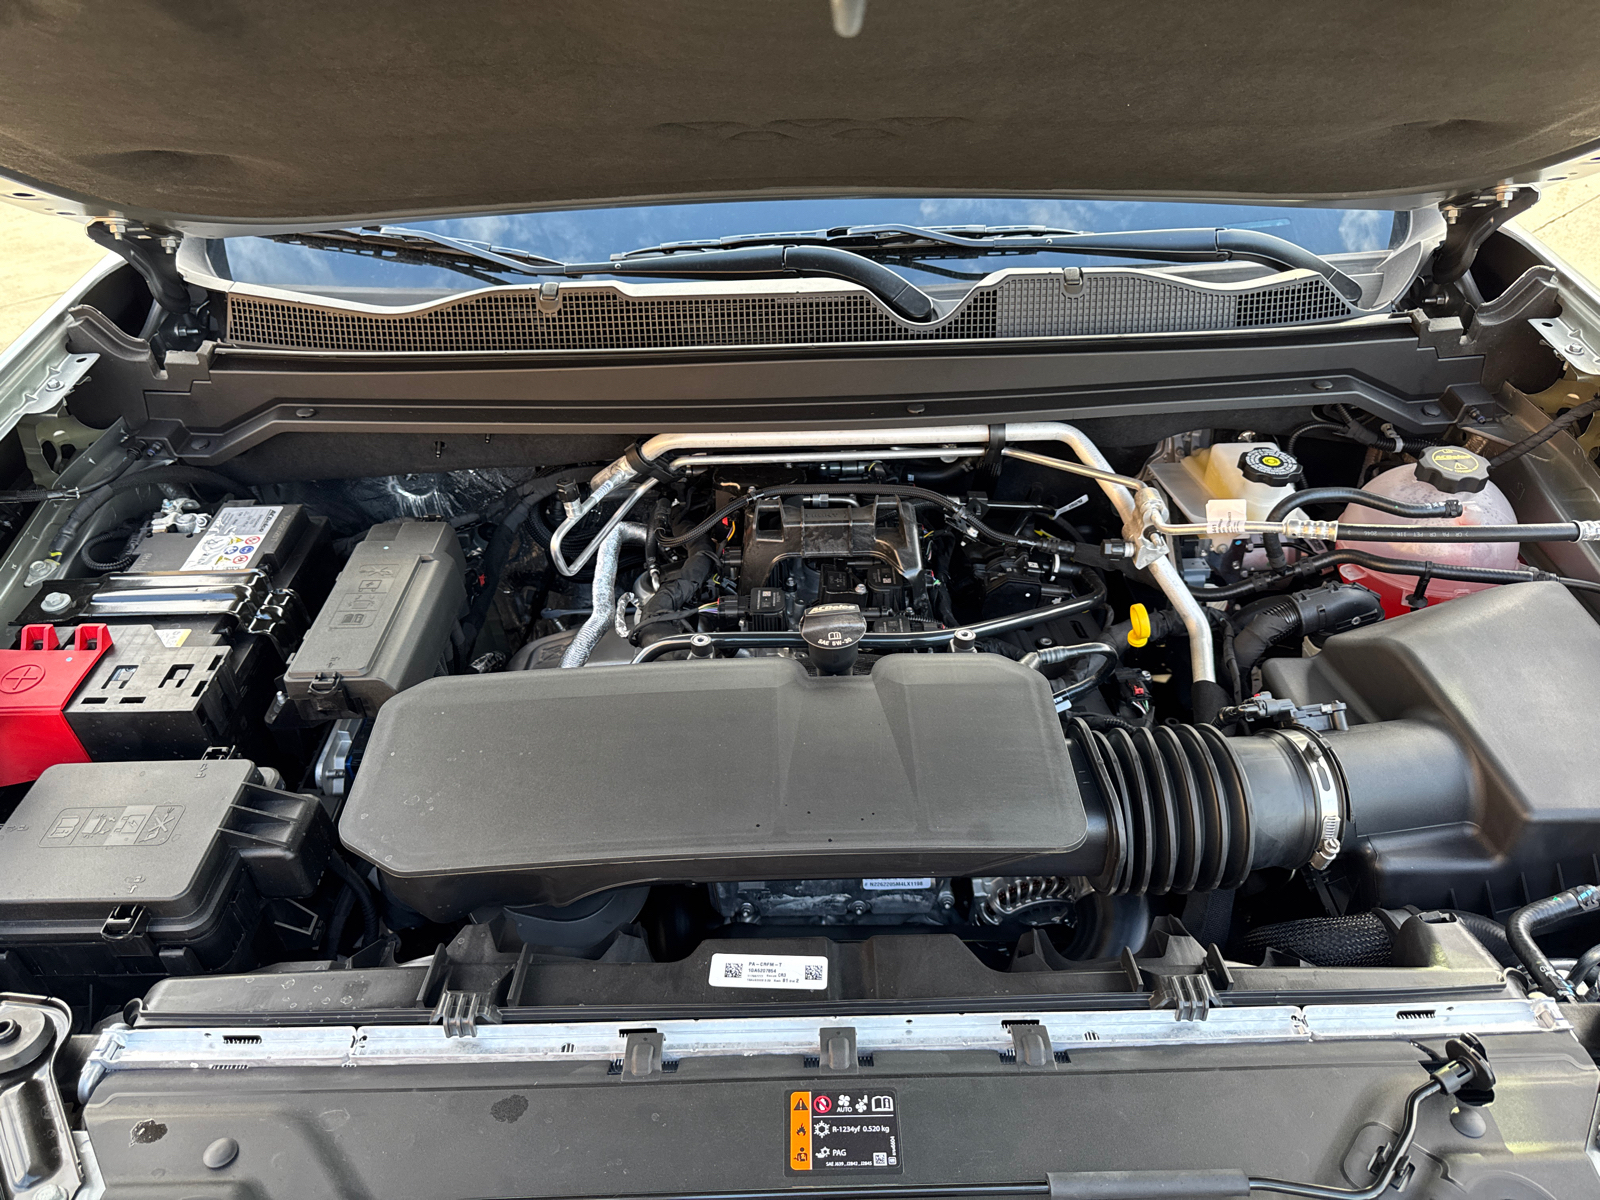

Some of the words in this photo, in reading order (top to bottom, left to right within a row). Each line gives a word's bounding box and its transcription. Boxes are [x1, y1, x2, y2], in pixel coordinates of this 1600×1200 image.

[808, 604, 856, 615] ACDelco
[817, 638, 830, 646] SAE
[831, 637, 853, 646] 5W-30
[832, 1125, 861, 1134] R-1234yf
[881, 1125, 890, 1134] kg
